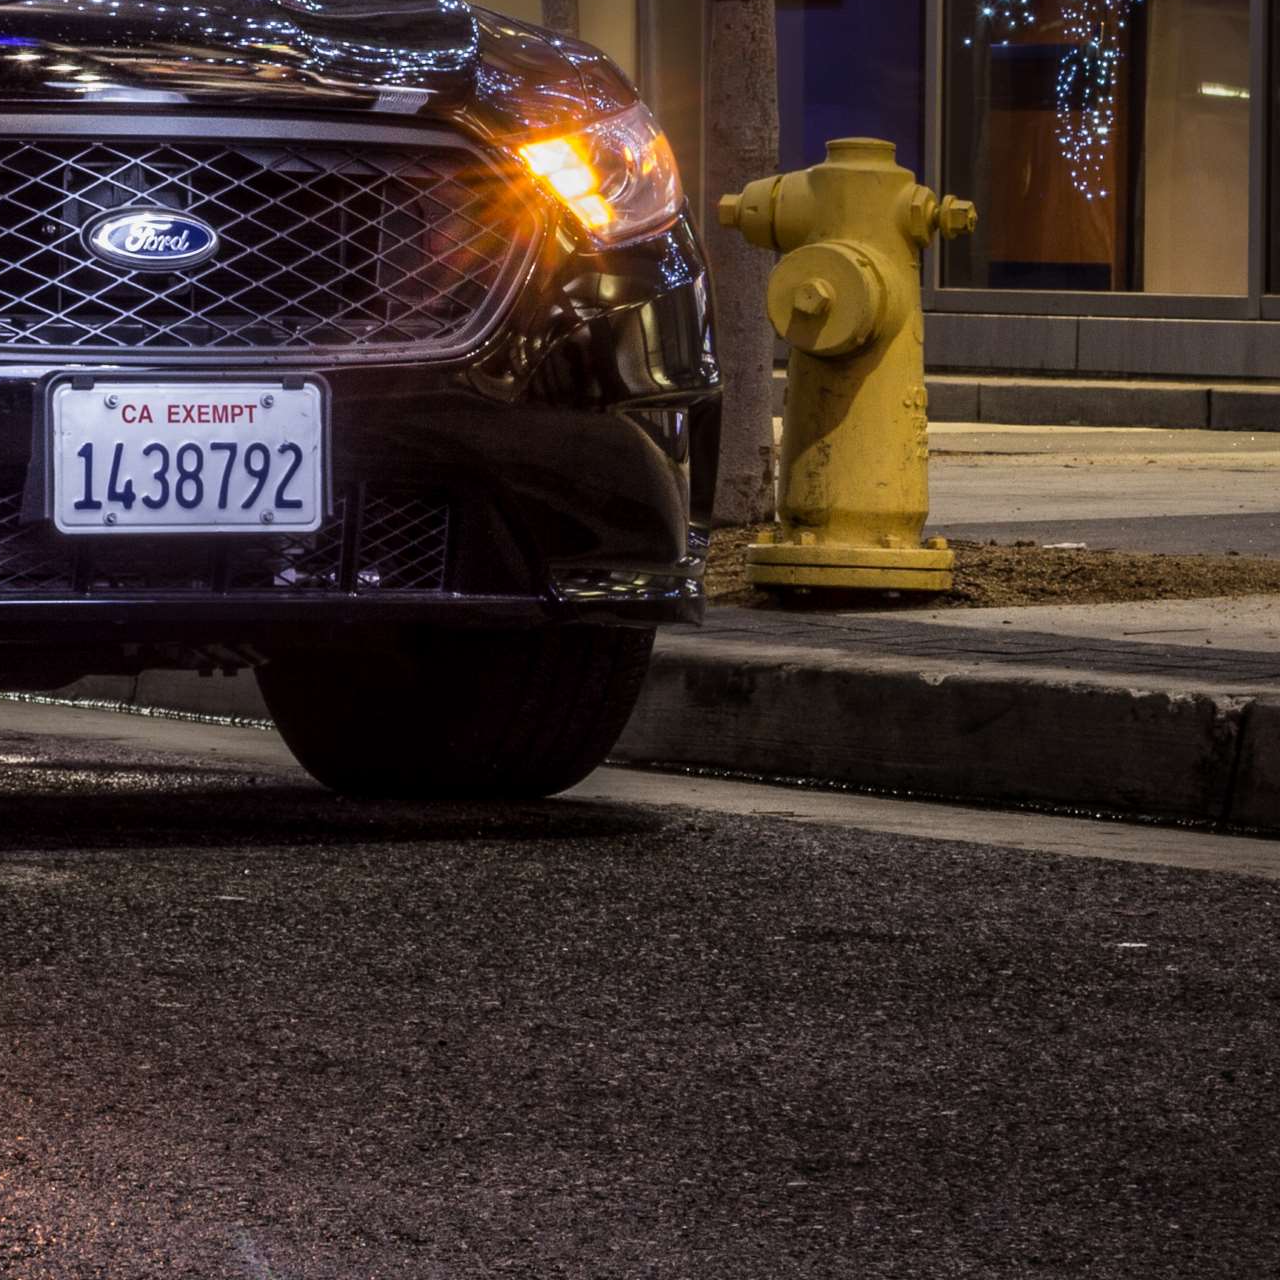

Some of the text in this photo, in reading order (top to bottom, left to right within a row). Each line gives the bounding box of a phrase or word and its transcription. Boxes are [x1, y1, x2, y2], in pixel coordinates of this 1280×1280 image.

[124, 219, 190, 252] Ford
[121, 404, 257, 424] CA EXEMPT
[74, 442, 303, 510] 1438792
